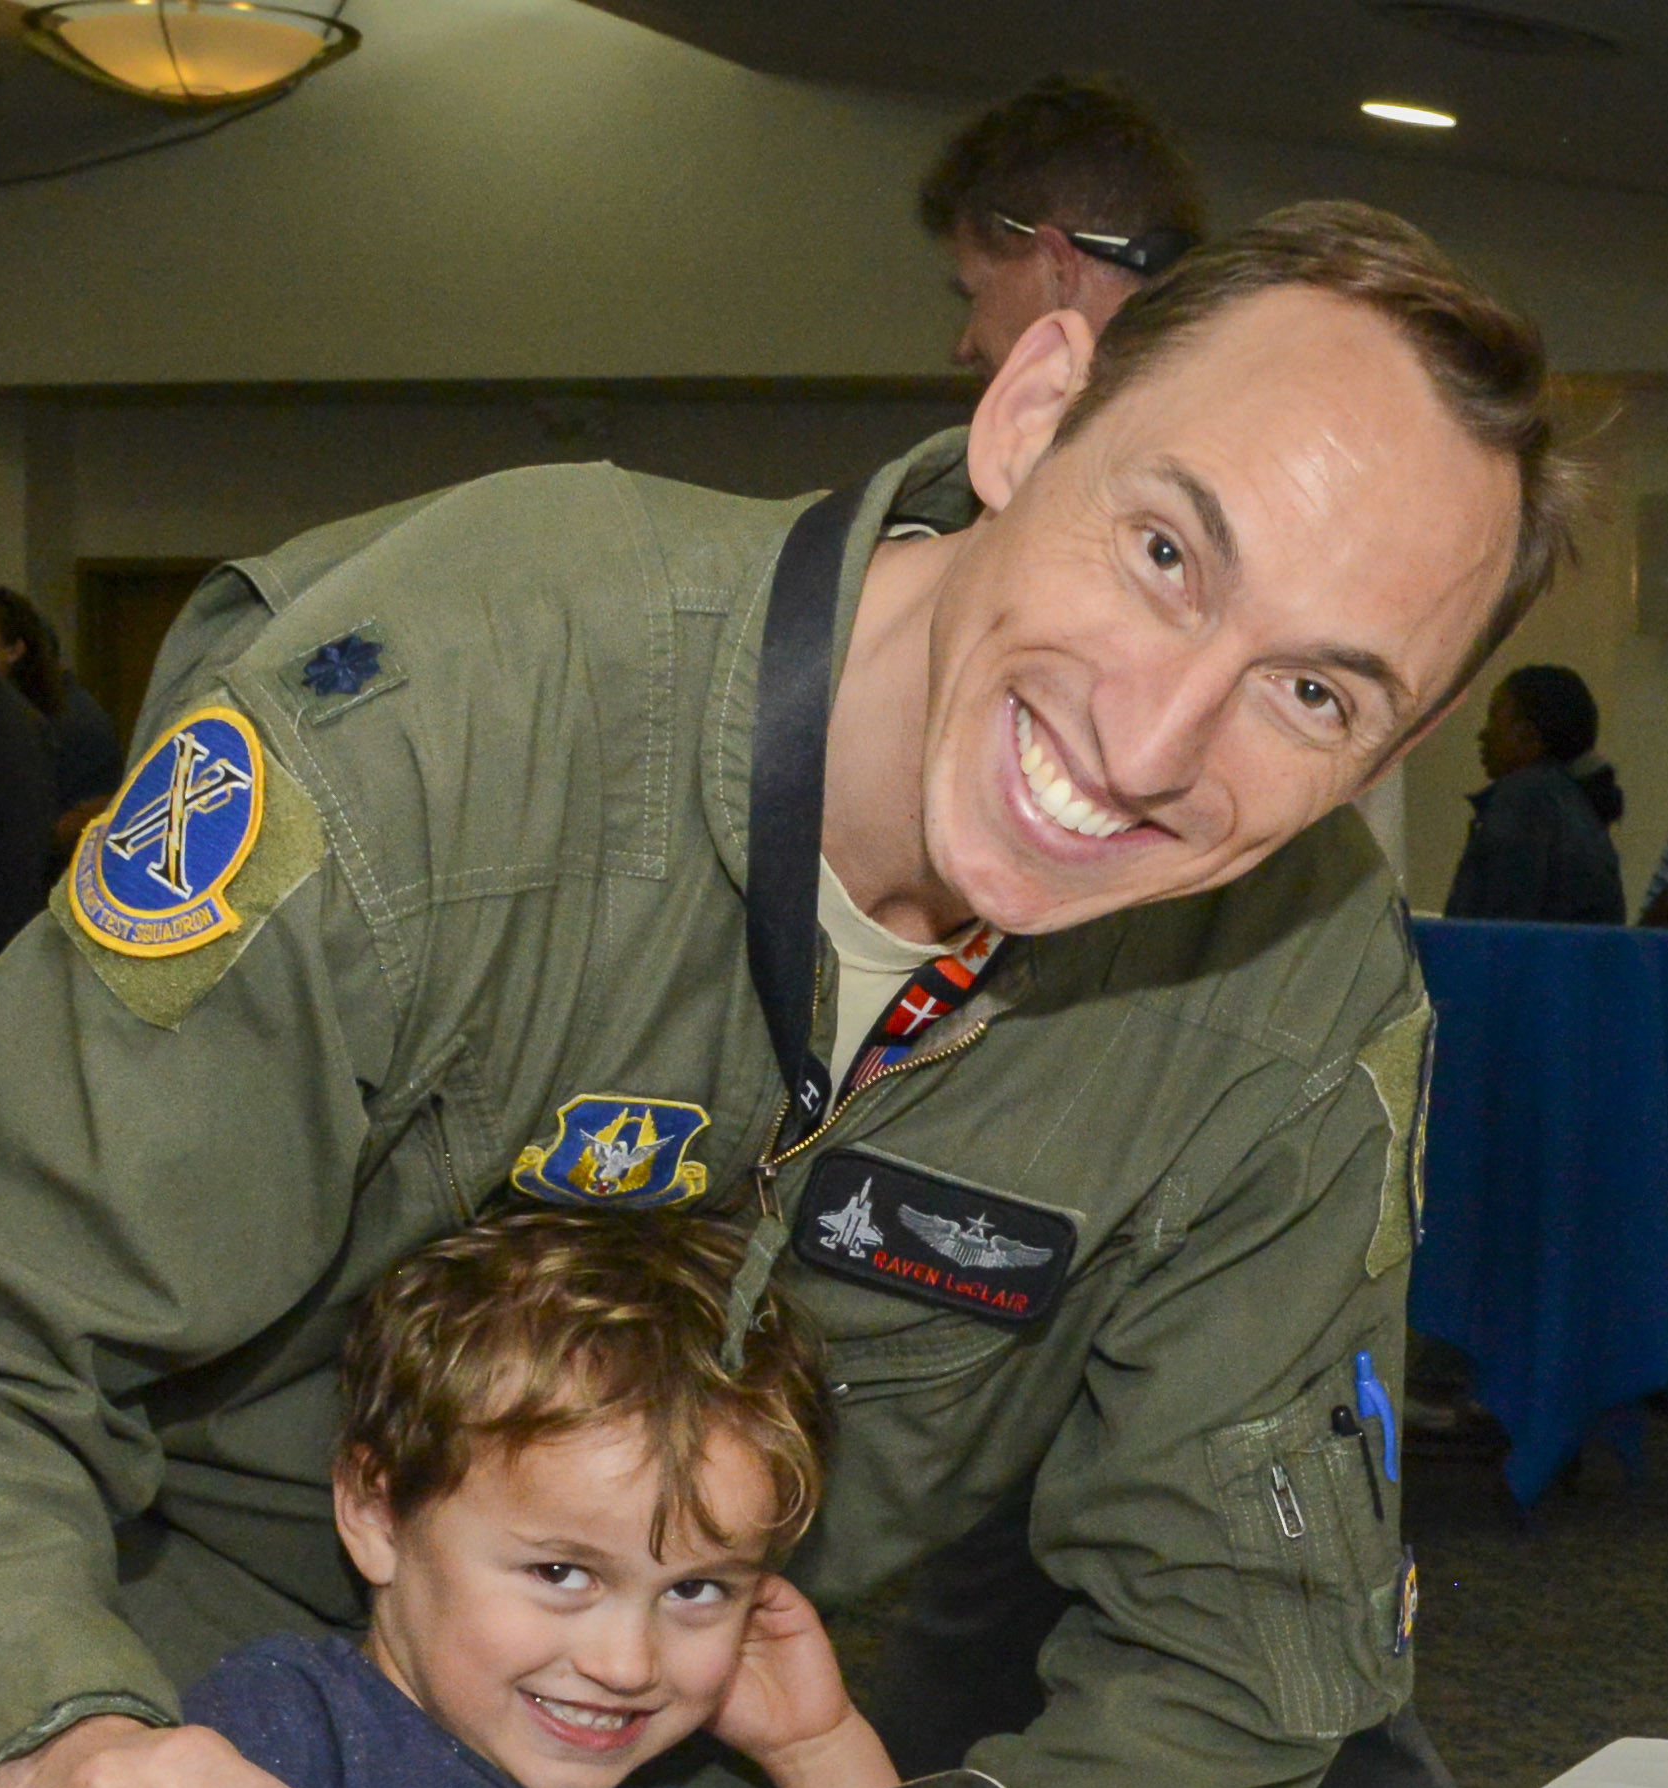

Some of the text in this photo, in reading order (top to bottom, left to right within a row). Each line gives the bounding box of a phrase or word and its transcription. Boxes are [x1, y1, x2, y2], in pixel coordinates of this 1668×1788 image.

[98, 905, 215, 943] TEST SQUADRON
[872, 1249, 1029, 1314] RAVEN LeCLAIR
